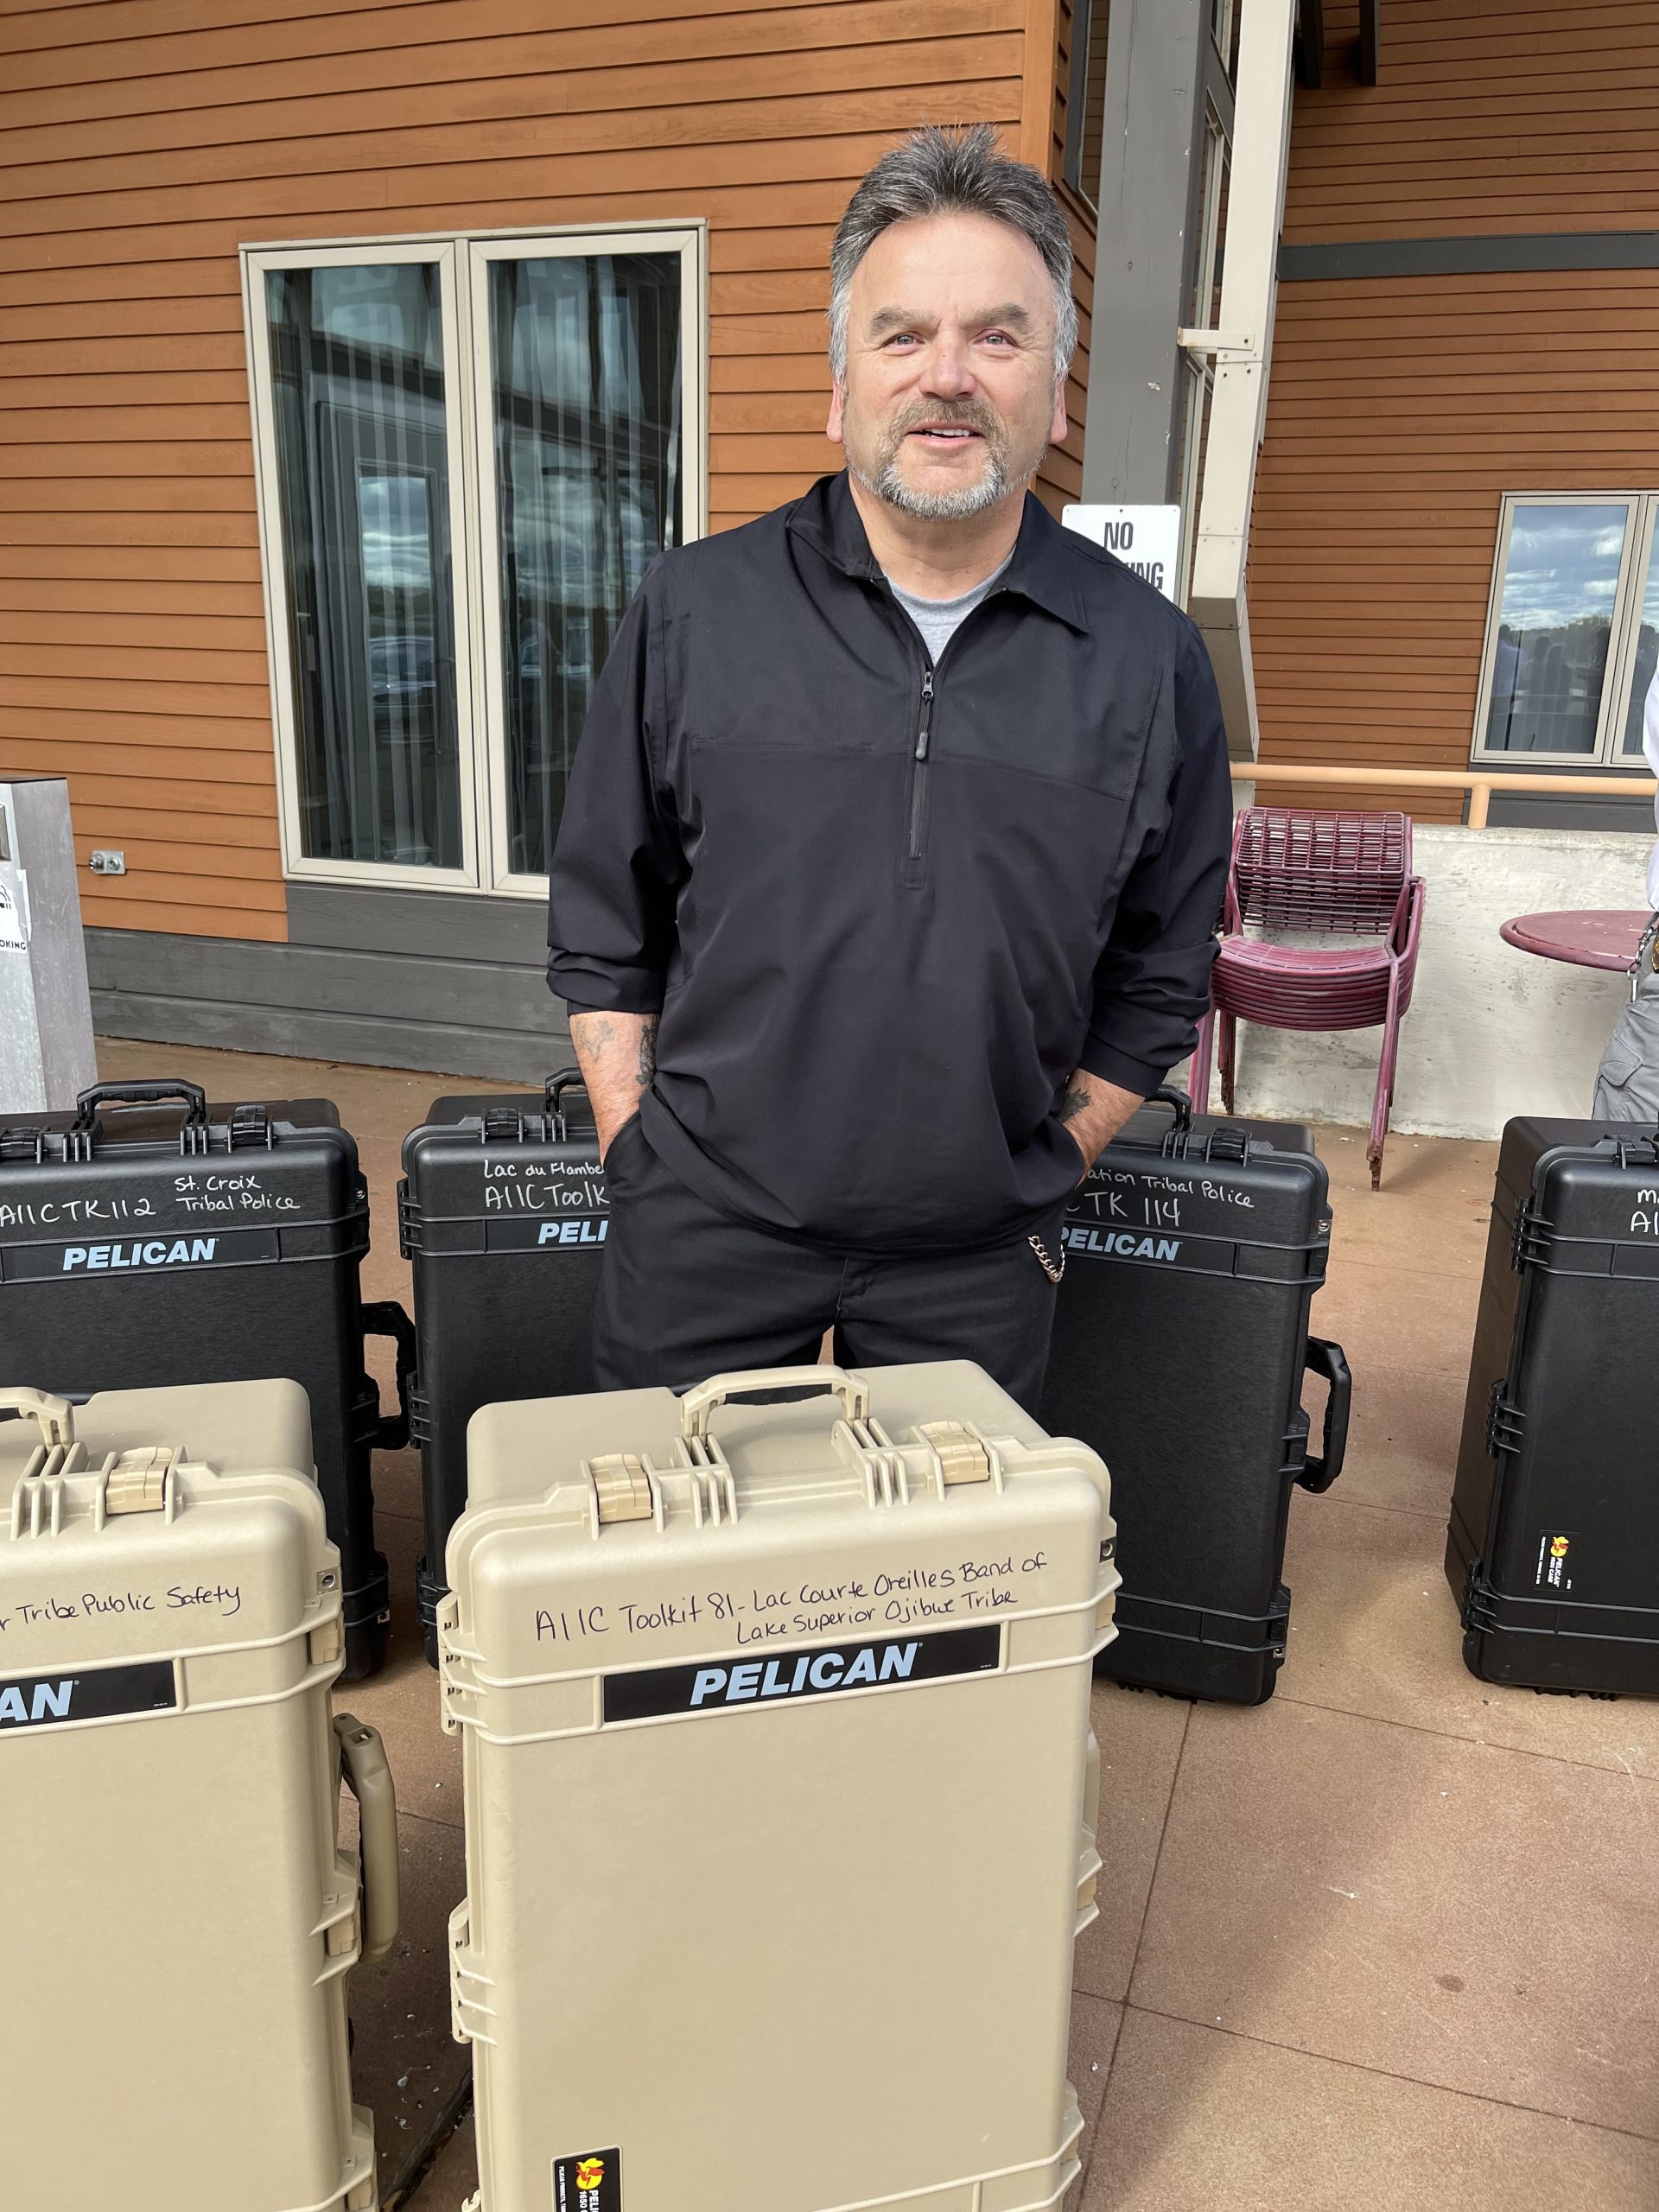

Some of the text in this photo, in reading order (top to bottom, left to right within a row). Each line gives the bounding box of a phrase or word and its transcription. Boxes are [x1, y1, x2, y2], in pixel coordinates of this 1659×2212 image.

[1104, 522, 1134, 550] NO
[175, 1175, 262, 1192] St. Croix
[484, 1160, 517, 1178] Lac
[525, 1165, 546, 1176] du
[175, 1192, 301, 1211] Tribal Police
[1141, 1175, 1193, 1194] Tribal
[1201, 1180, 1255, 1208] Police
[1144, 1198, 1180, 1227] 114
[538, 1220, 608, 1244] PELI
[63, 1239, 216, 1271] PELICAN
[16, 1598, 79, 1624] Tribe
[81, 1593, 156, 1617] Public
[166, 1585, 241, 1617] Safety
[619, 1595, 702, 1633] Toolkit
[753, 1589, 791, 1611] Lac
[799, 1580, 868, 1604] Courte
[874, 1569, 956, 1597] Oreilles
[958, 1556, 1014, 1583] Band
[1021, 1551, 1047, 1573] of
[737, 1621, 788, 1644] Lake
[792, 1607, 876, 1633] Superior
[960, 1587, 1018, 1610] Tribe
[690, 1642, 919, 1707] PELICAN
[0, 1680, 73, 1722] AN
[579, 2190, 588, 2209] 1650
